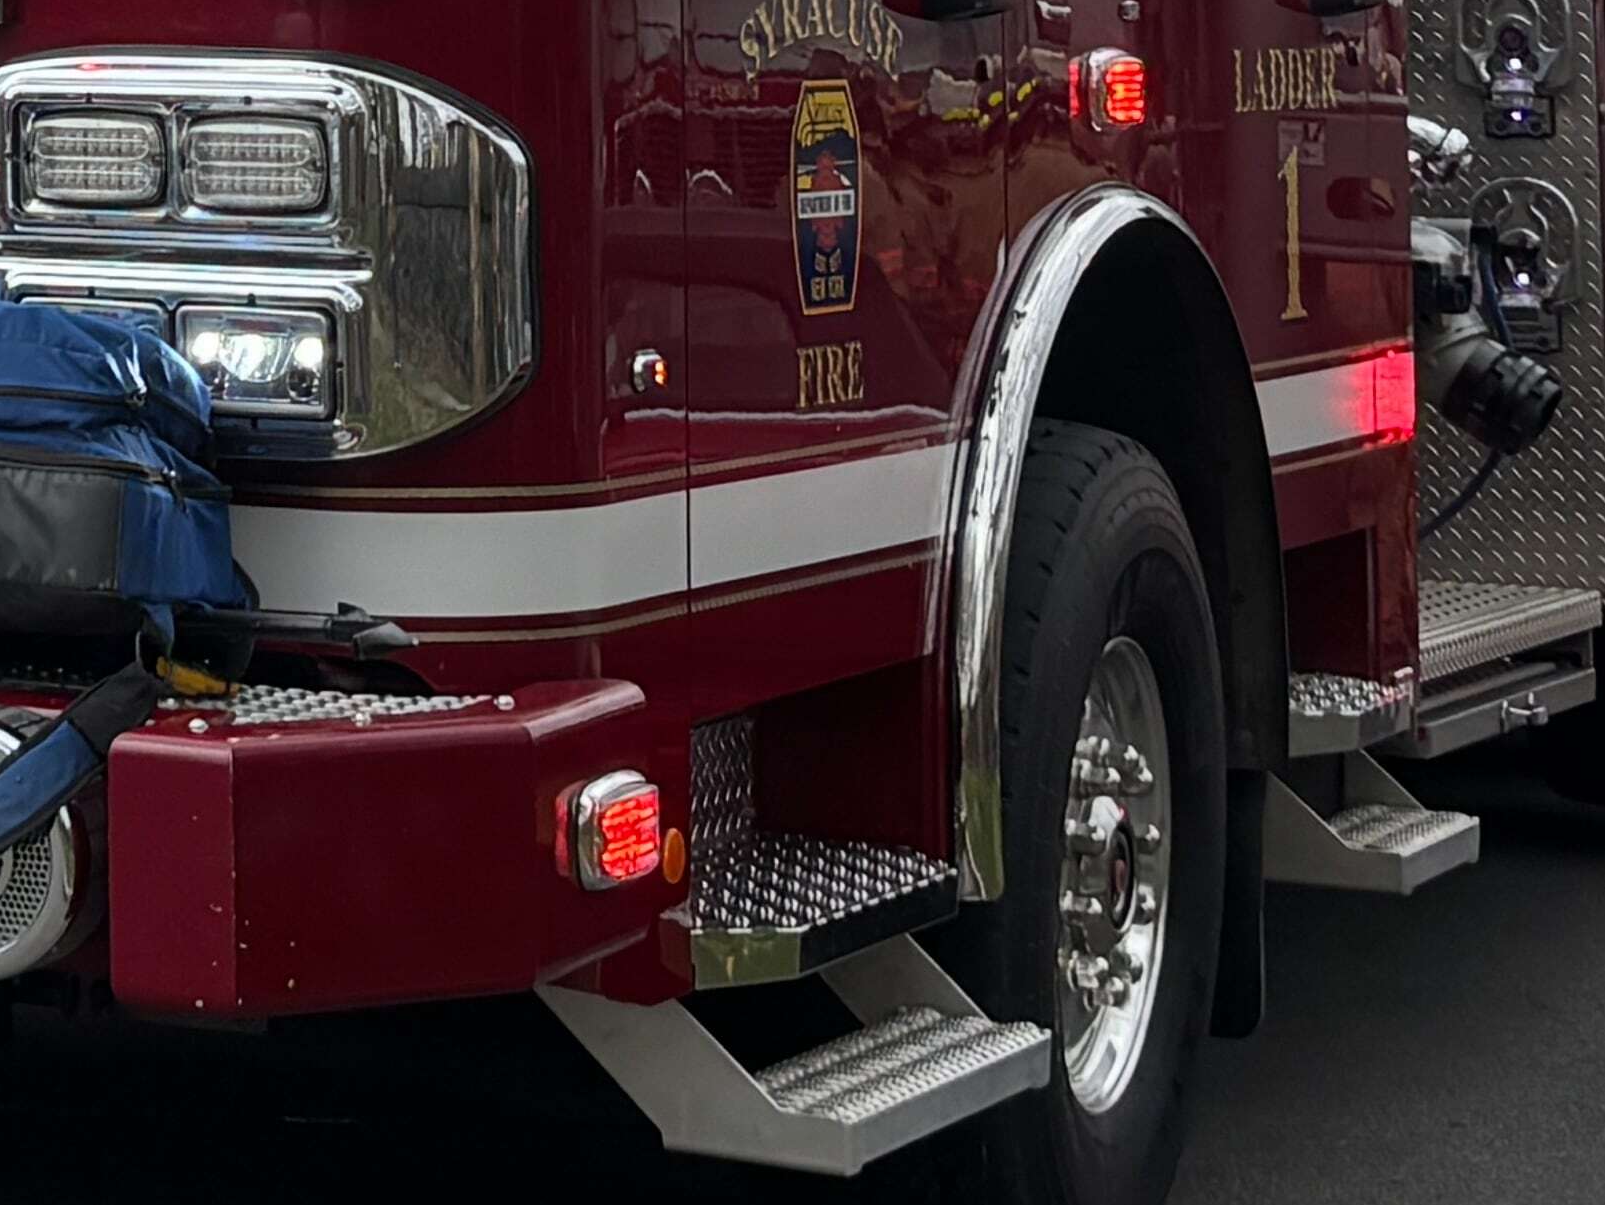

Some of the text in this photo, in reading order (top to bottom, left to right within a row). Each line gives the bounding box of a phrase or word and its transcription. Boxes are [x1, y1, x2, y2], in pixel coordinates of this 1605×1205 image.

[1233, 47, 1338, 113] LADDER
[1277, 145, 1309, 321] 1
[796, 339, 865, 409] FIRE
